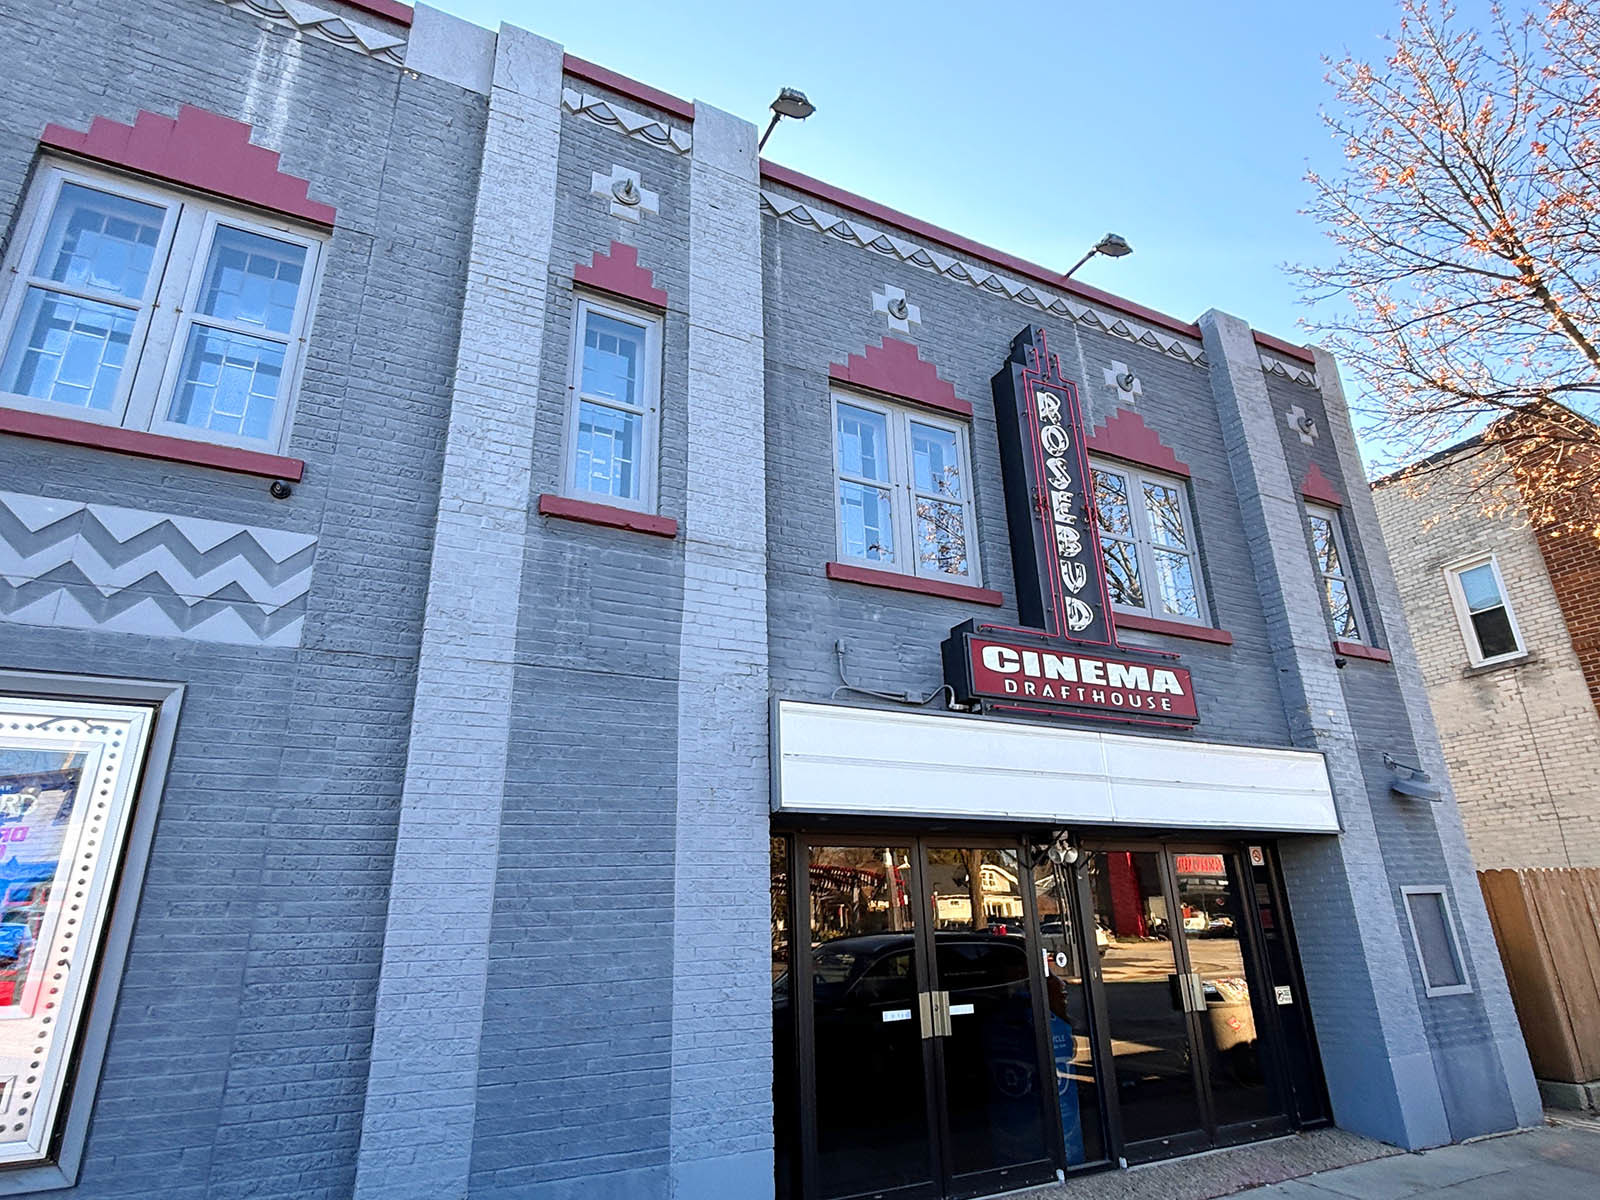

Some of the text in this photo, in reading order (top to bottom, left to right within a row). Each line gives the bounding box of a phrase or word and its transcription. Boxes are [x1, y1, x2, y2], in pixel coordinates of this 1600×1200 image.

[1036, 391, 1094, 632] ROSEBUD
[981, 645, 1185, 696] CINEMA
[1004, 679, 1172, 711] DRAFTHOUSE
